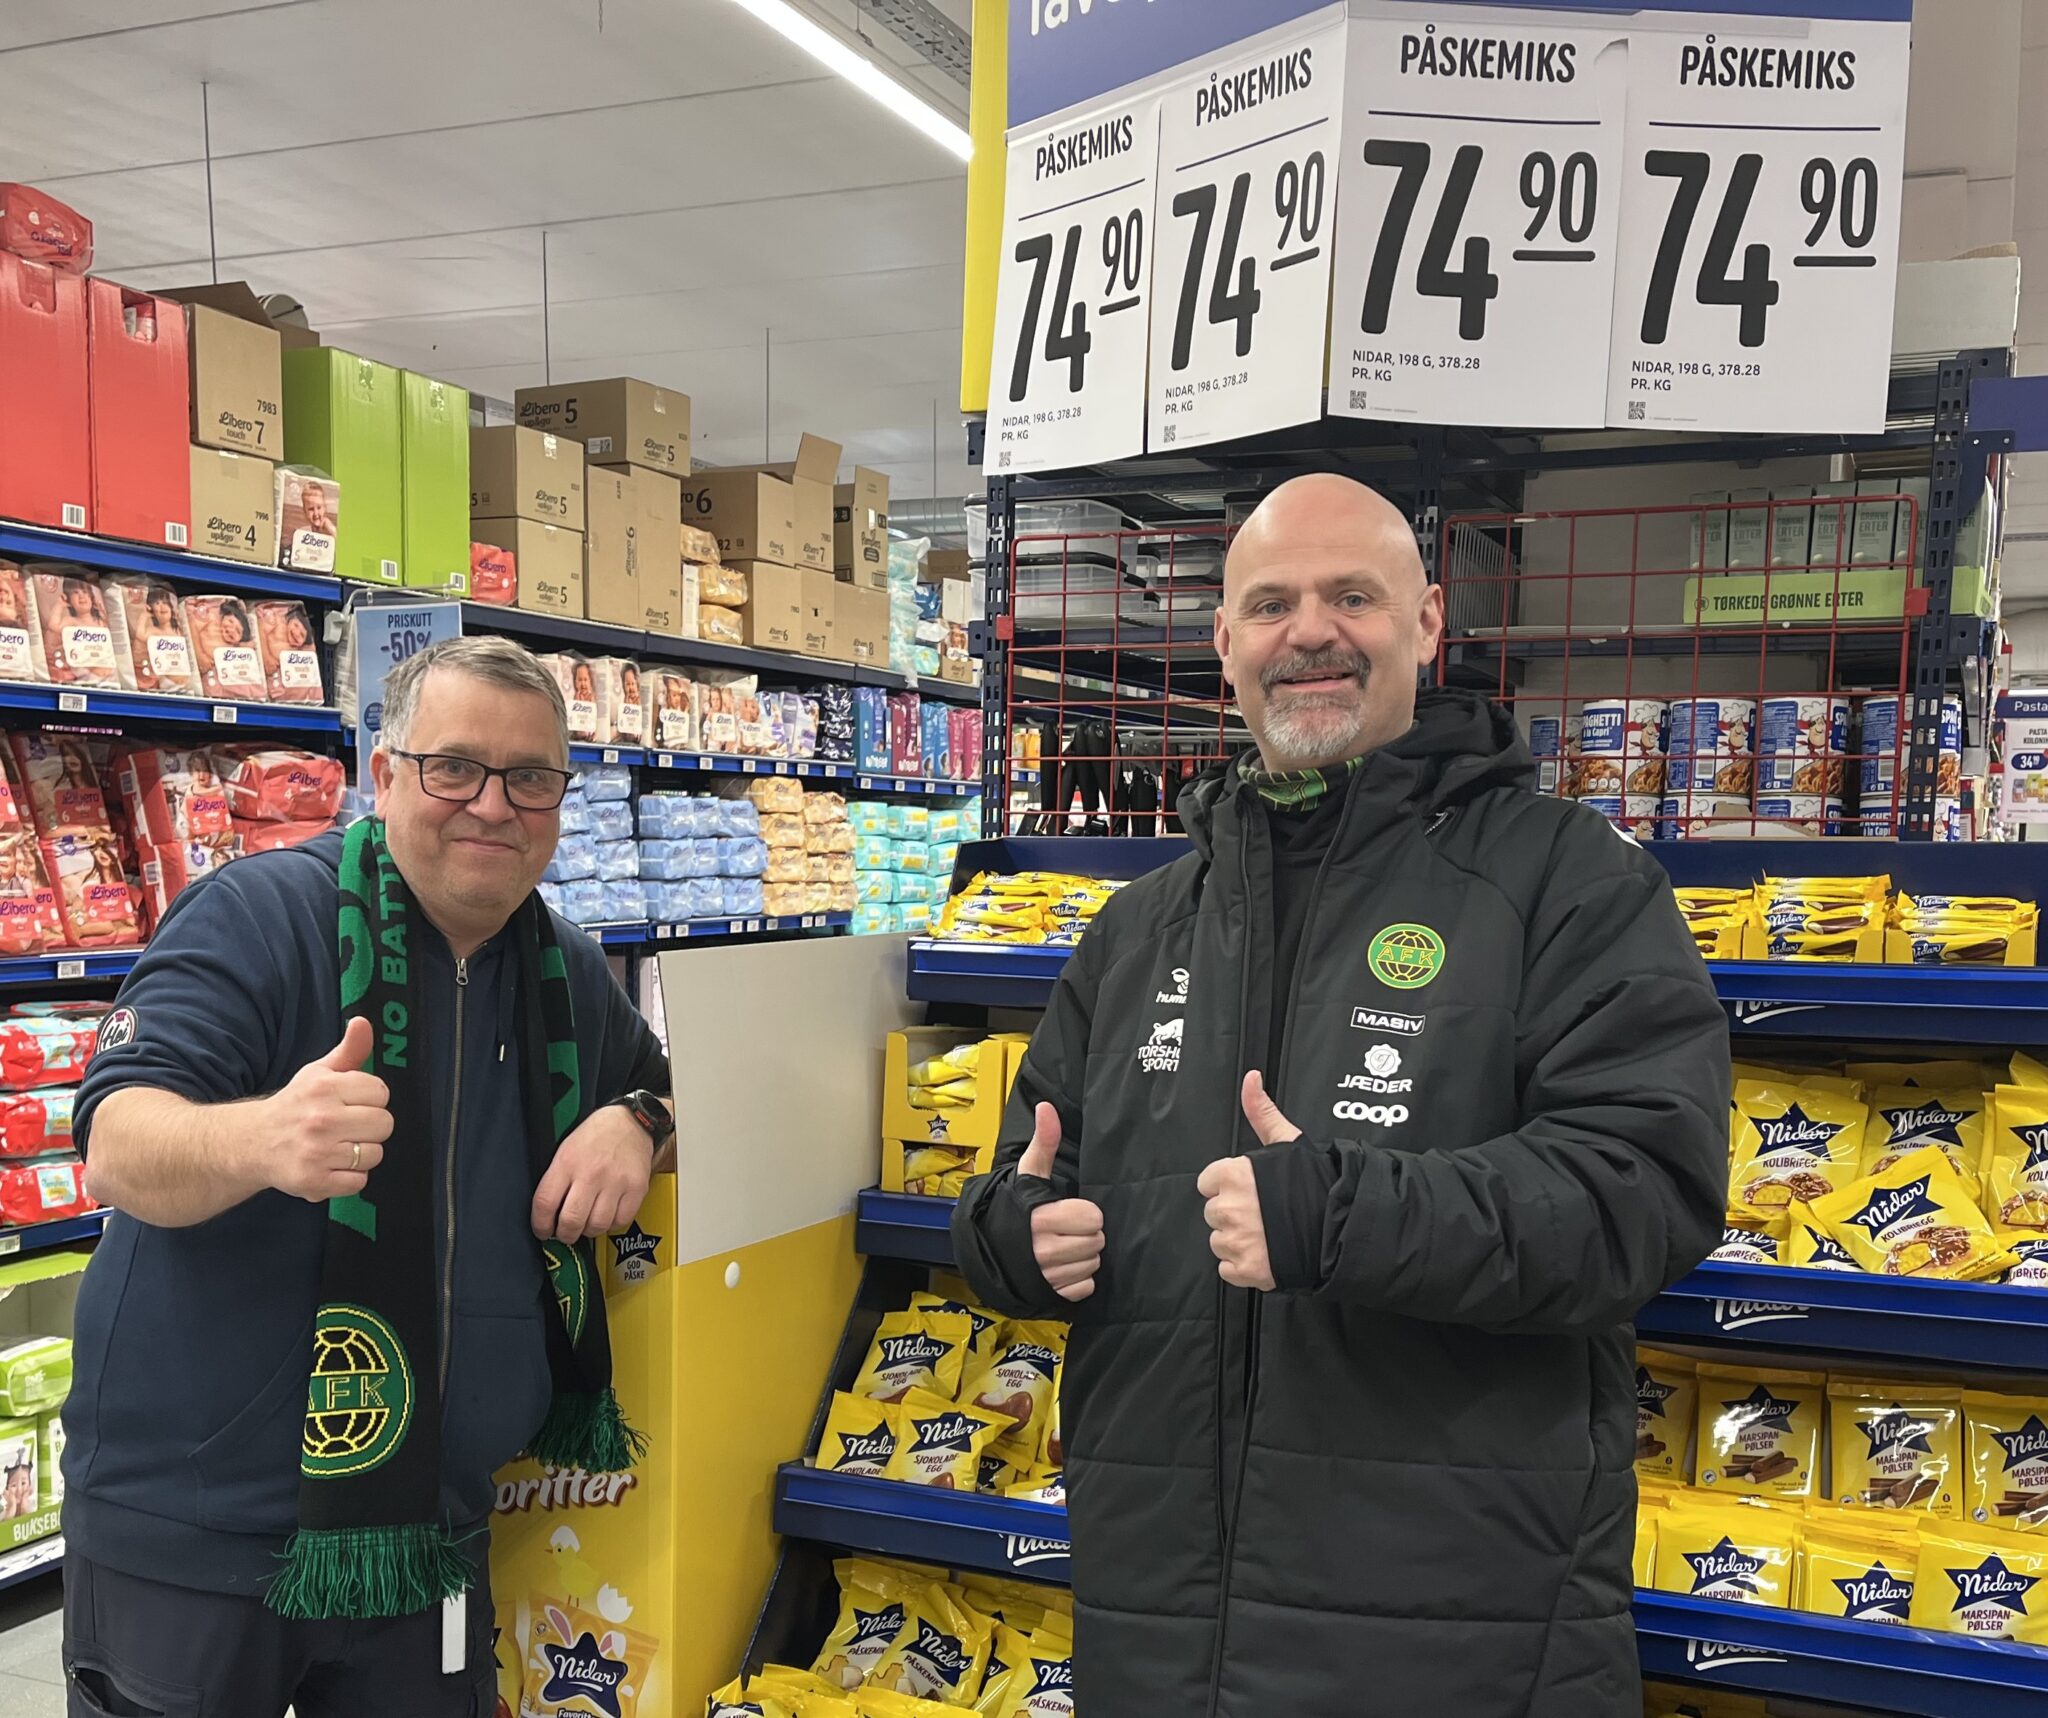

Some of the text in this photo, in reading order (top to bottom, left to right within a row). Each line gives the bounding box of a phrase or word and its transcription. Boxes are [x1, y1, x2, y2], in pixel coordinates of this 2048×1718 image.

[1400, 24, 1576, 84] PÅSKEMIKS
[1680, 34, 1856, 90] PÅSKEMIKS
[1196, 47, 1313, 127] PÅSKEMIKS
[1035, 114, 1133, 181] PÅSKEMIKS
[1361, 139, 1598, 341] 74 90
[1640, 149, 1878, 348] 74 90
[1171, 151, 1325, 371] 74 90
[1008, 208, 1143, 403] 74 90
[1352, 349, 1481, 370] NIDAR, 198 G, 378.28
[1631, 360, 1761, 378] NIDAR, 198 G, 378.28
[1352, 367, 1392, 382] PR. KG
[1165, 372, 1248, 399] NIDAR, 198 G, 378.28
[1631, 378, 1672, 391] PR. KG
[257, 400, 277, 415] 7983
[520, 398, 578, 424] Libero 5
[1165, 400, 1193, 414] PR. KG
[1002, 407, 1082, 427] NIDAR, 198 G, 378.28
[219, 411, 252, 432] Libero
[254, 420, 265, 445] 7
[1001, 430, 1029, 441] PR. KG
[667, 445, 675, 463] 5
[535, 489, 567, 515] Libero 5
[696, 488, 712, 514] 6
[207, 516, 257, 547] Libero 4
[301, 533, 329, 549] Libero
[560, 586, 567, 604] 5
[1713, 595, 1767, 612] TØRKEDE
[1770, 593, 1821, 610] GRØNNE
[388, 612, 432, 628] PRISKUTT
[663, 611, 670, 626] 5
[0, 632, 24, 645] bero
[72, 629, 107, 643] Libero
[157, 638, 185, 652] Libero
[2020, 755, 2033, 769] 34
[192, 799, 226, 812] Libero
[61, 811, 70, 823] 6
[36, 893, 53, 904] ero
[90, 881, 127, 899] Libero
[0, 901, 37, 916] Libero
[1052, 907, 1078, 917] Nidar
[1061, 923, 1086, 934] Nidar
[1769, 914, 1806, 927] Nidar
[1357, 1012, 1423, 1032] MASIV
[102, 1022, 130, 1050] Hei
[381, 1001, 408, 1068] NO
[1143, 1059, 1180, 1073] SPORT
[1337, 1075, 1413, 1094] JÆDER
[1332, 1101, 1409, 1127] coop
[1891, 1111, 1963, 1135] Nidar
[1762, 1121, 1831, 1146] Nidar
[1857, 1181, 1925, 1228] Nidar
[1881, 1216, 1935, 1243] KOLIBRIEGG
[616, 1233, 656, 1255] Nidar
[627, 1260, 641, 1269] GOD
[625, 1270, 645, 1280] PÅSKE
[883, 1338, 945, 1360] Nidar
[892, 1377, 908, 1387] EGG
[1005, 1379, 1023, 1389] EGG
[1637, 1380, 1668, 1399] dar
[308, 1375, 386, 1411] FK
[920, 1421, 982, 1444] Nidar
[23, 1437, 35, 1462] 7
[846, 1436, 896, 1457] Nida
[1744, 1441, 1774, 1451] PØLSER
[2003, 1430, 2048, 1457] Nida
[914, 1453, 960, 1465] SJOKOLADE-
[925, 1464, 943, 1473] EGG
[1882, 1462, 1913, 1475] PØLSER
[2012, 1467, 2048, 1479] MARSIPA
[494, 1464, 636, 1511] oritter
[1041, 1489, 1060, 1498] EGG
[1694, 1553, 1758, 1579] Nidar
[1845, 1580, 1913, 1606] Nidar
[1957, 1570, 2029, 1597] Nidar
[1960, 1609, 2015, 1622] MARSIPAN-
[860, 1616, 906, 1637] Nida
[1967, 1620, 2004, 1632] PØLSER
[847, 1644, 887, 1656] PÅSKEMIK
[919, 1627, 974, 1670] Nidar
[554, 1654, 617, 1685] Nidar
[904, 1654, 945, 1691] PÅSKEMIKS
[557, 1708, 597, 1718] Favoritt
[1028, 1697, 1073, 1714] PÅSKEMIK
